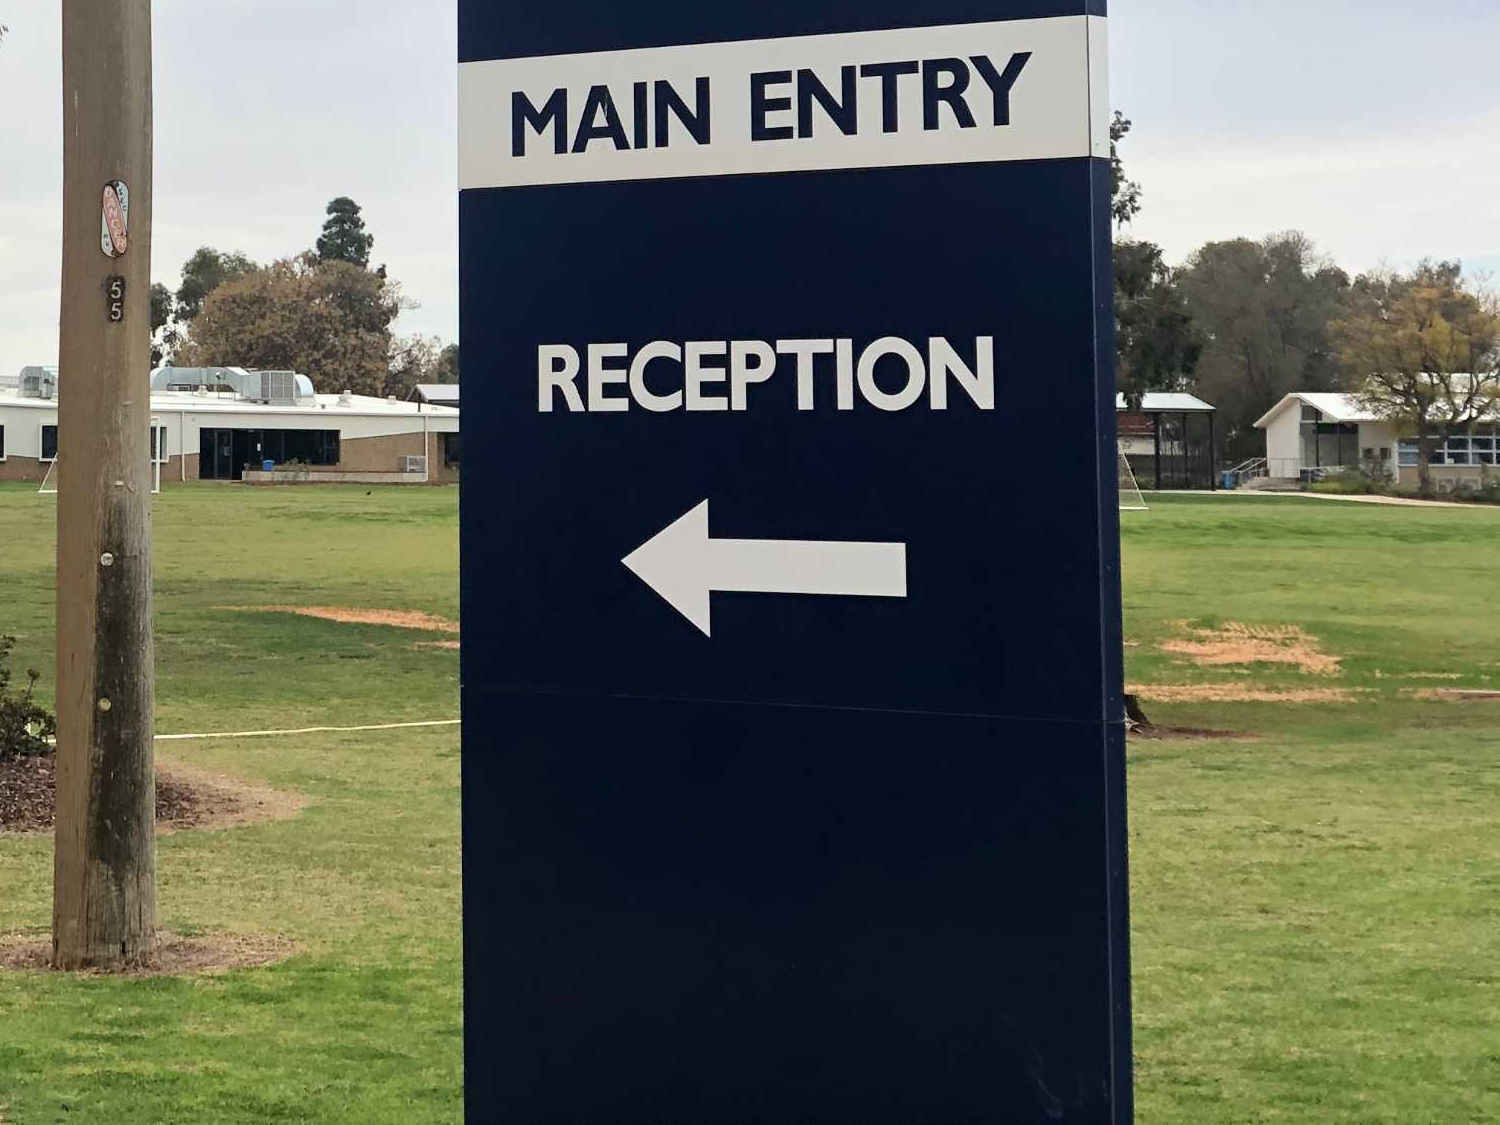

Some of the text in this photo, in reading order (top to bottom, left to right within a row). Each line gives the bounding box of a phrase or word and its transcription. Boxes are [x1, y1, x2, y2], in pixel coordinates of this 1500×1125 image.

[511, 51, 1033, 158] MAIN ENTRY
[538, 335, 995, 413] RECEPTION
